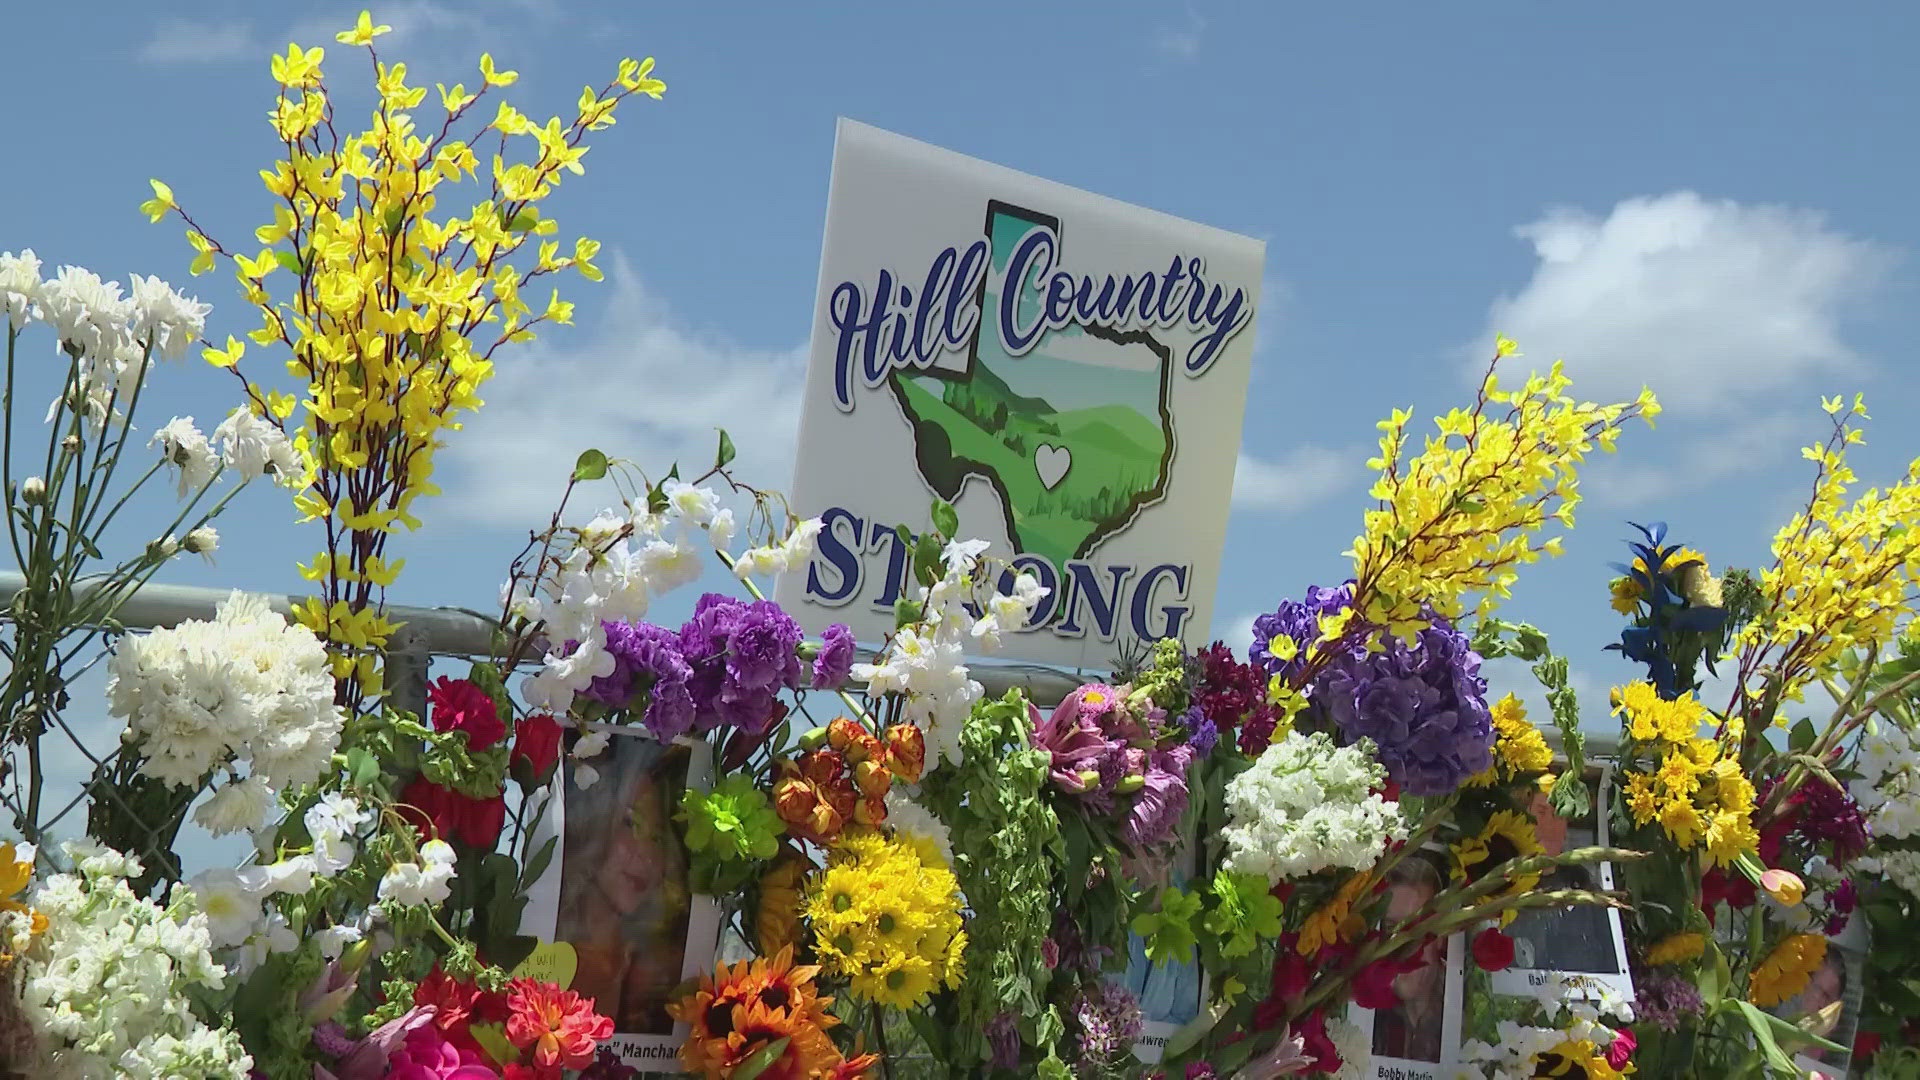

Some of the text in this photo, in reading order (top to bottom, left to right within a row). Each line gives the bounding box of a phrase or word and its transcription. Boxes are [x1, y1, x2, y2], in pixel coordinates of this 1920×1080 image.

[830, 231, 1247, 404] Hill Country
[806, 507, 1188, 642] STONG
